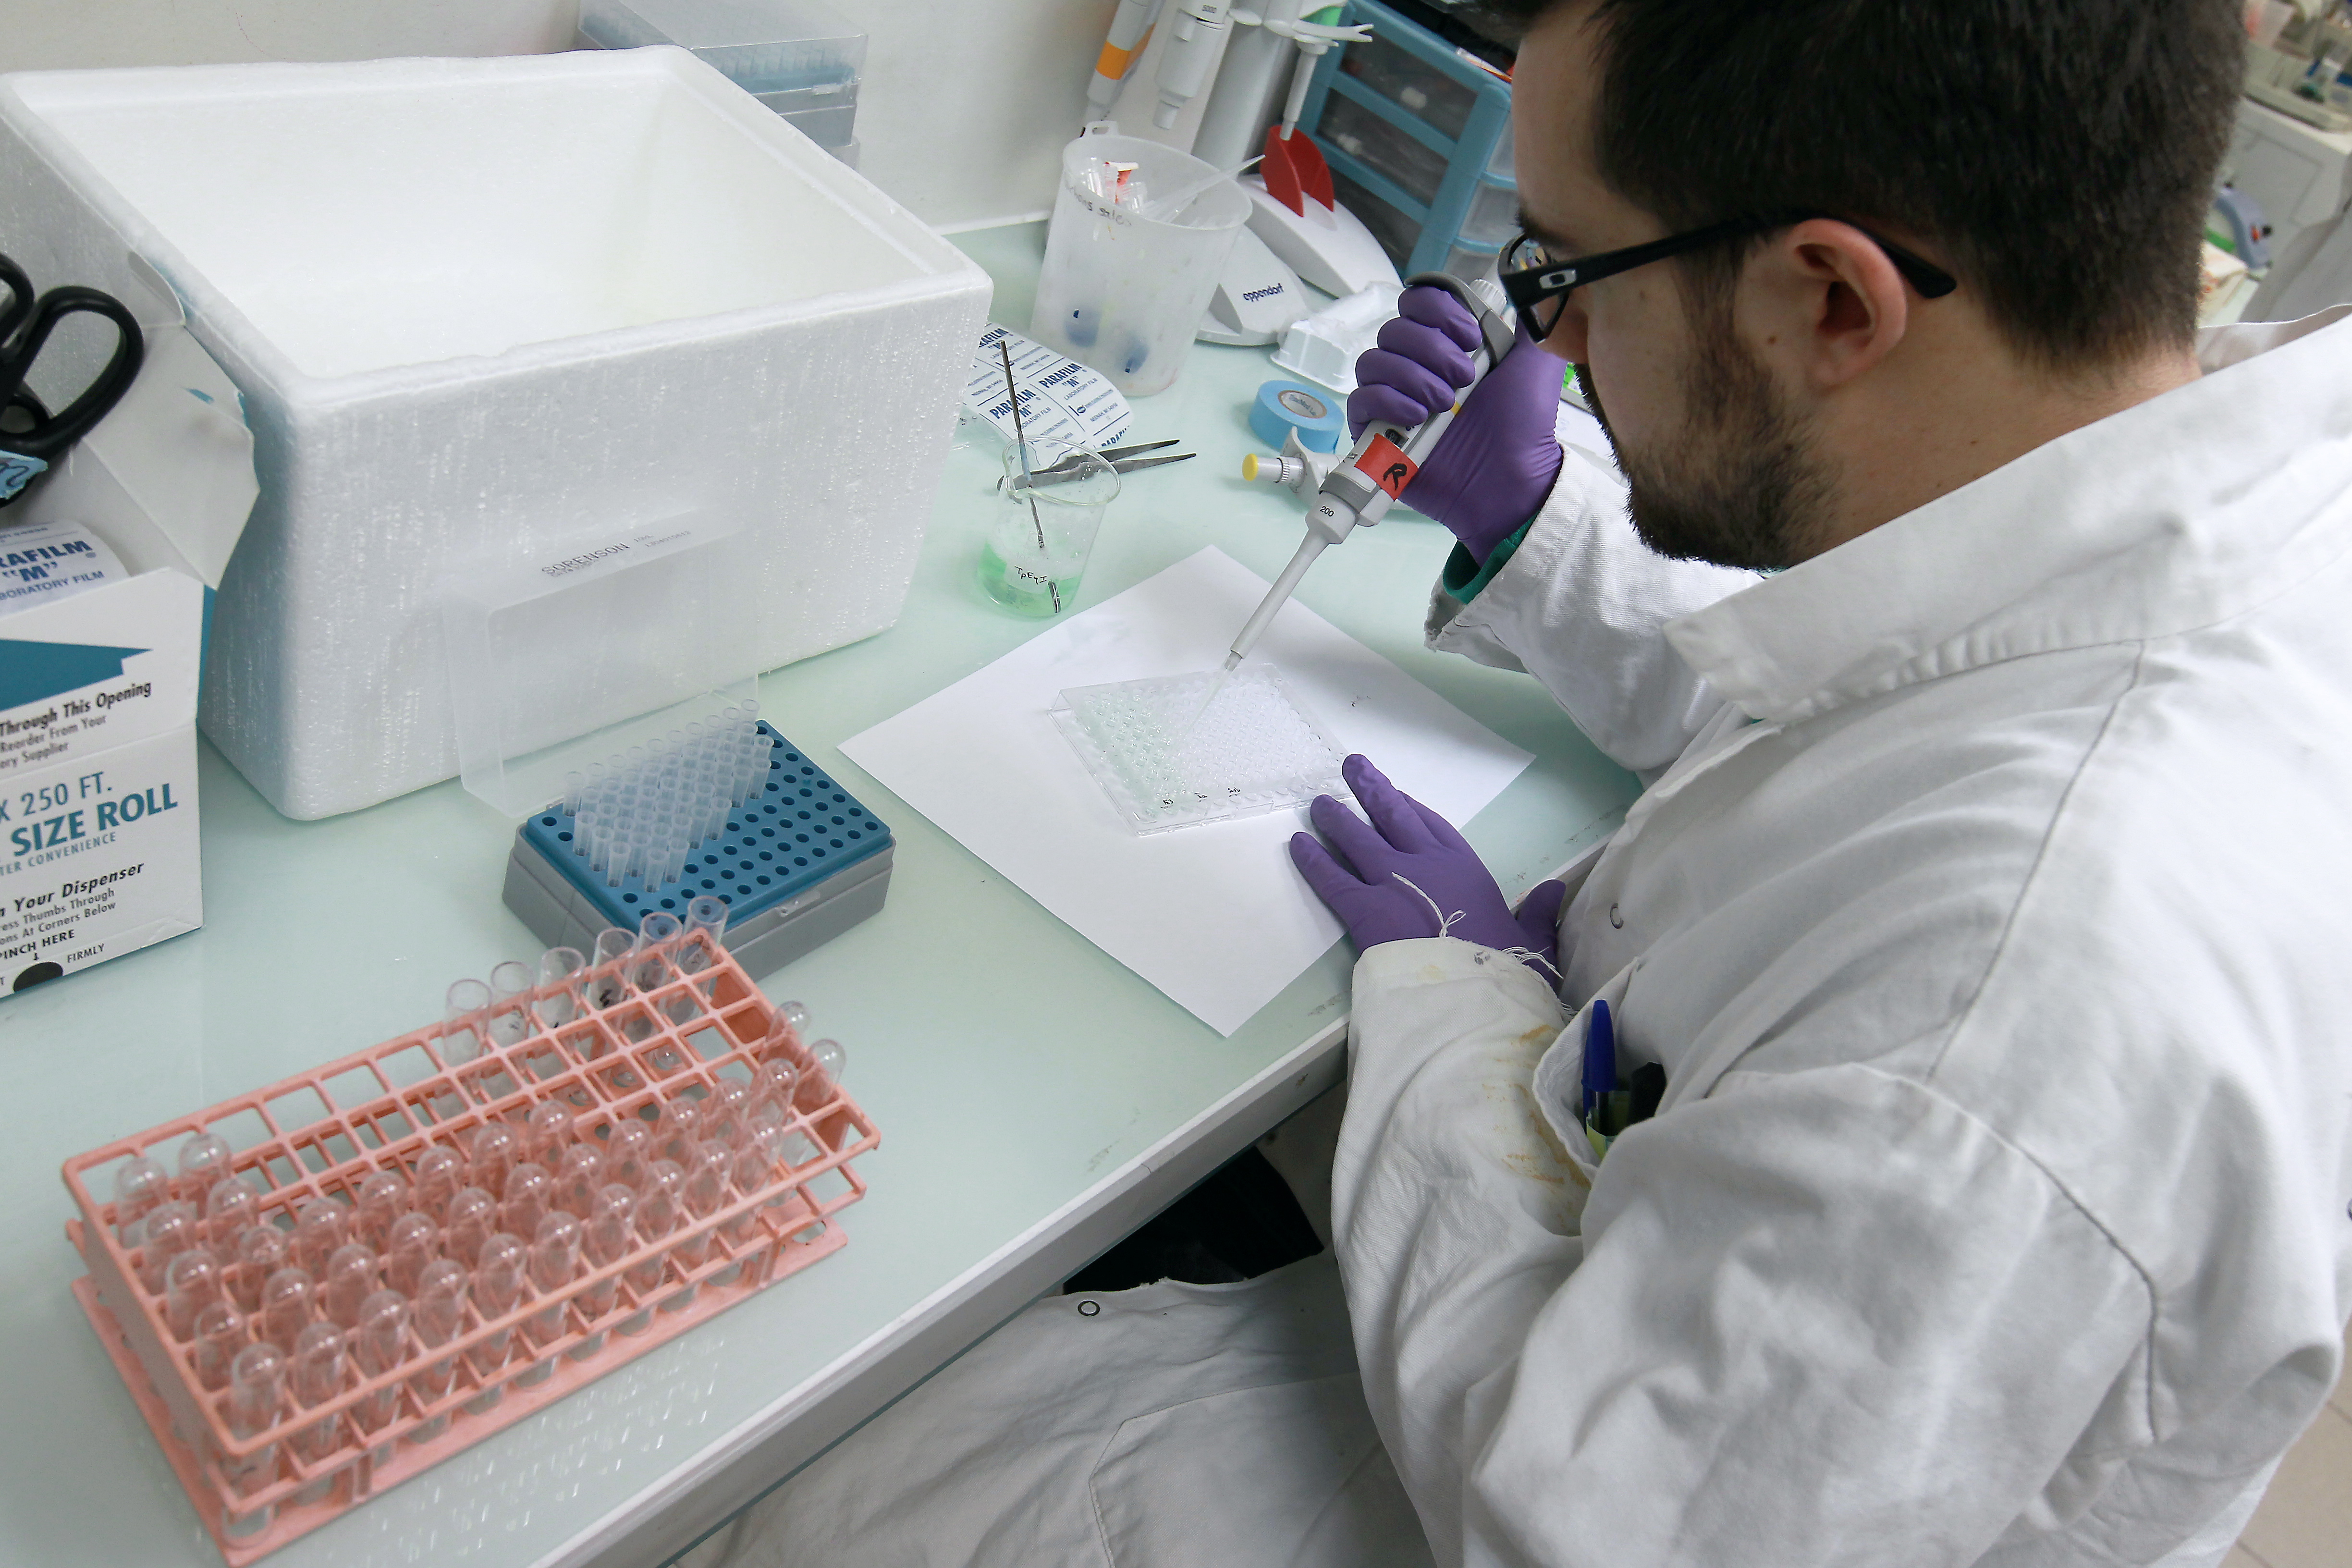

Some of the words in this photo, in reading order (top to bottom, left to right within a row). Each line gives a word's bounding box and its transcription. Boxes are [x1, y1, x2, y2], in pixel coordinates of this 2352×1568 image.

[1243, 282, 1284, 302] eppendorf
[1038, 363, 1082, 388] PARAFILM
[989, 389, 1037, 419] PARILM
[1064, 383, 1089, 401] LABORATORY
[1041, 406, 1052, 415] FILM
[1383, 463, 1408, 490] R
[1320, 506, 1334, 517] 200
[542, 542, 630, 574] SORENSON
[73, 570, 105, 584] FILM
[0, 708, 58, 736] Through
[63, 699, 91, 718] This
[97, 682, 152, 709] Opening
[0, 734, 45, 753] Reorder
[49, 724, 79, 739] From
[81, 715, 106, 729] Your
[22, 743, 69, 763] Supplier
[20, 783, 69, 816] 250
[79, 772, 112, 798] FT.
[11, 809, 86, 857] SIZE
[97, 783, 178, 831] ROLL
[28, 832, 116, 867] CONVENIENCE
[14, 892, 55, 912] Your
[61, 862, 145, 898] Dispenser
[23, 904, 67, 925] Thumbs
[70, 888, 115, 909] Through
[23, 927, 34, 938] At
[38, 913, 80, 932] Corners
[84, 902, 116, 919] Below
[42, 929, 75, 947] HERE
[66, 943, 104, 963] FIRMLY
